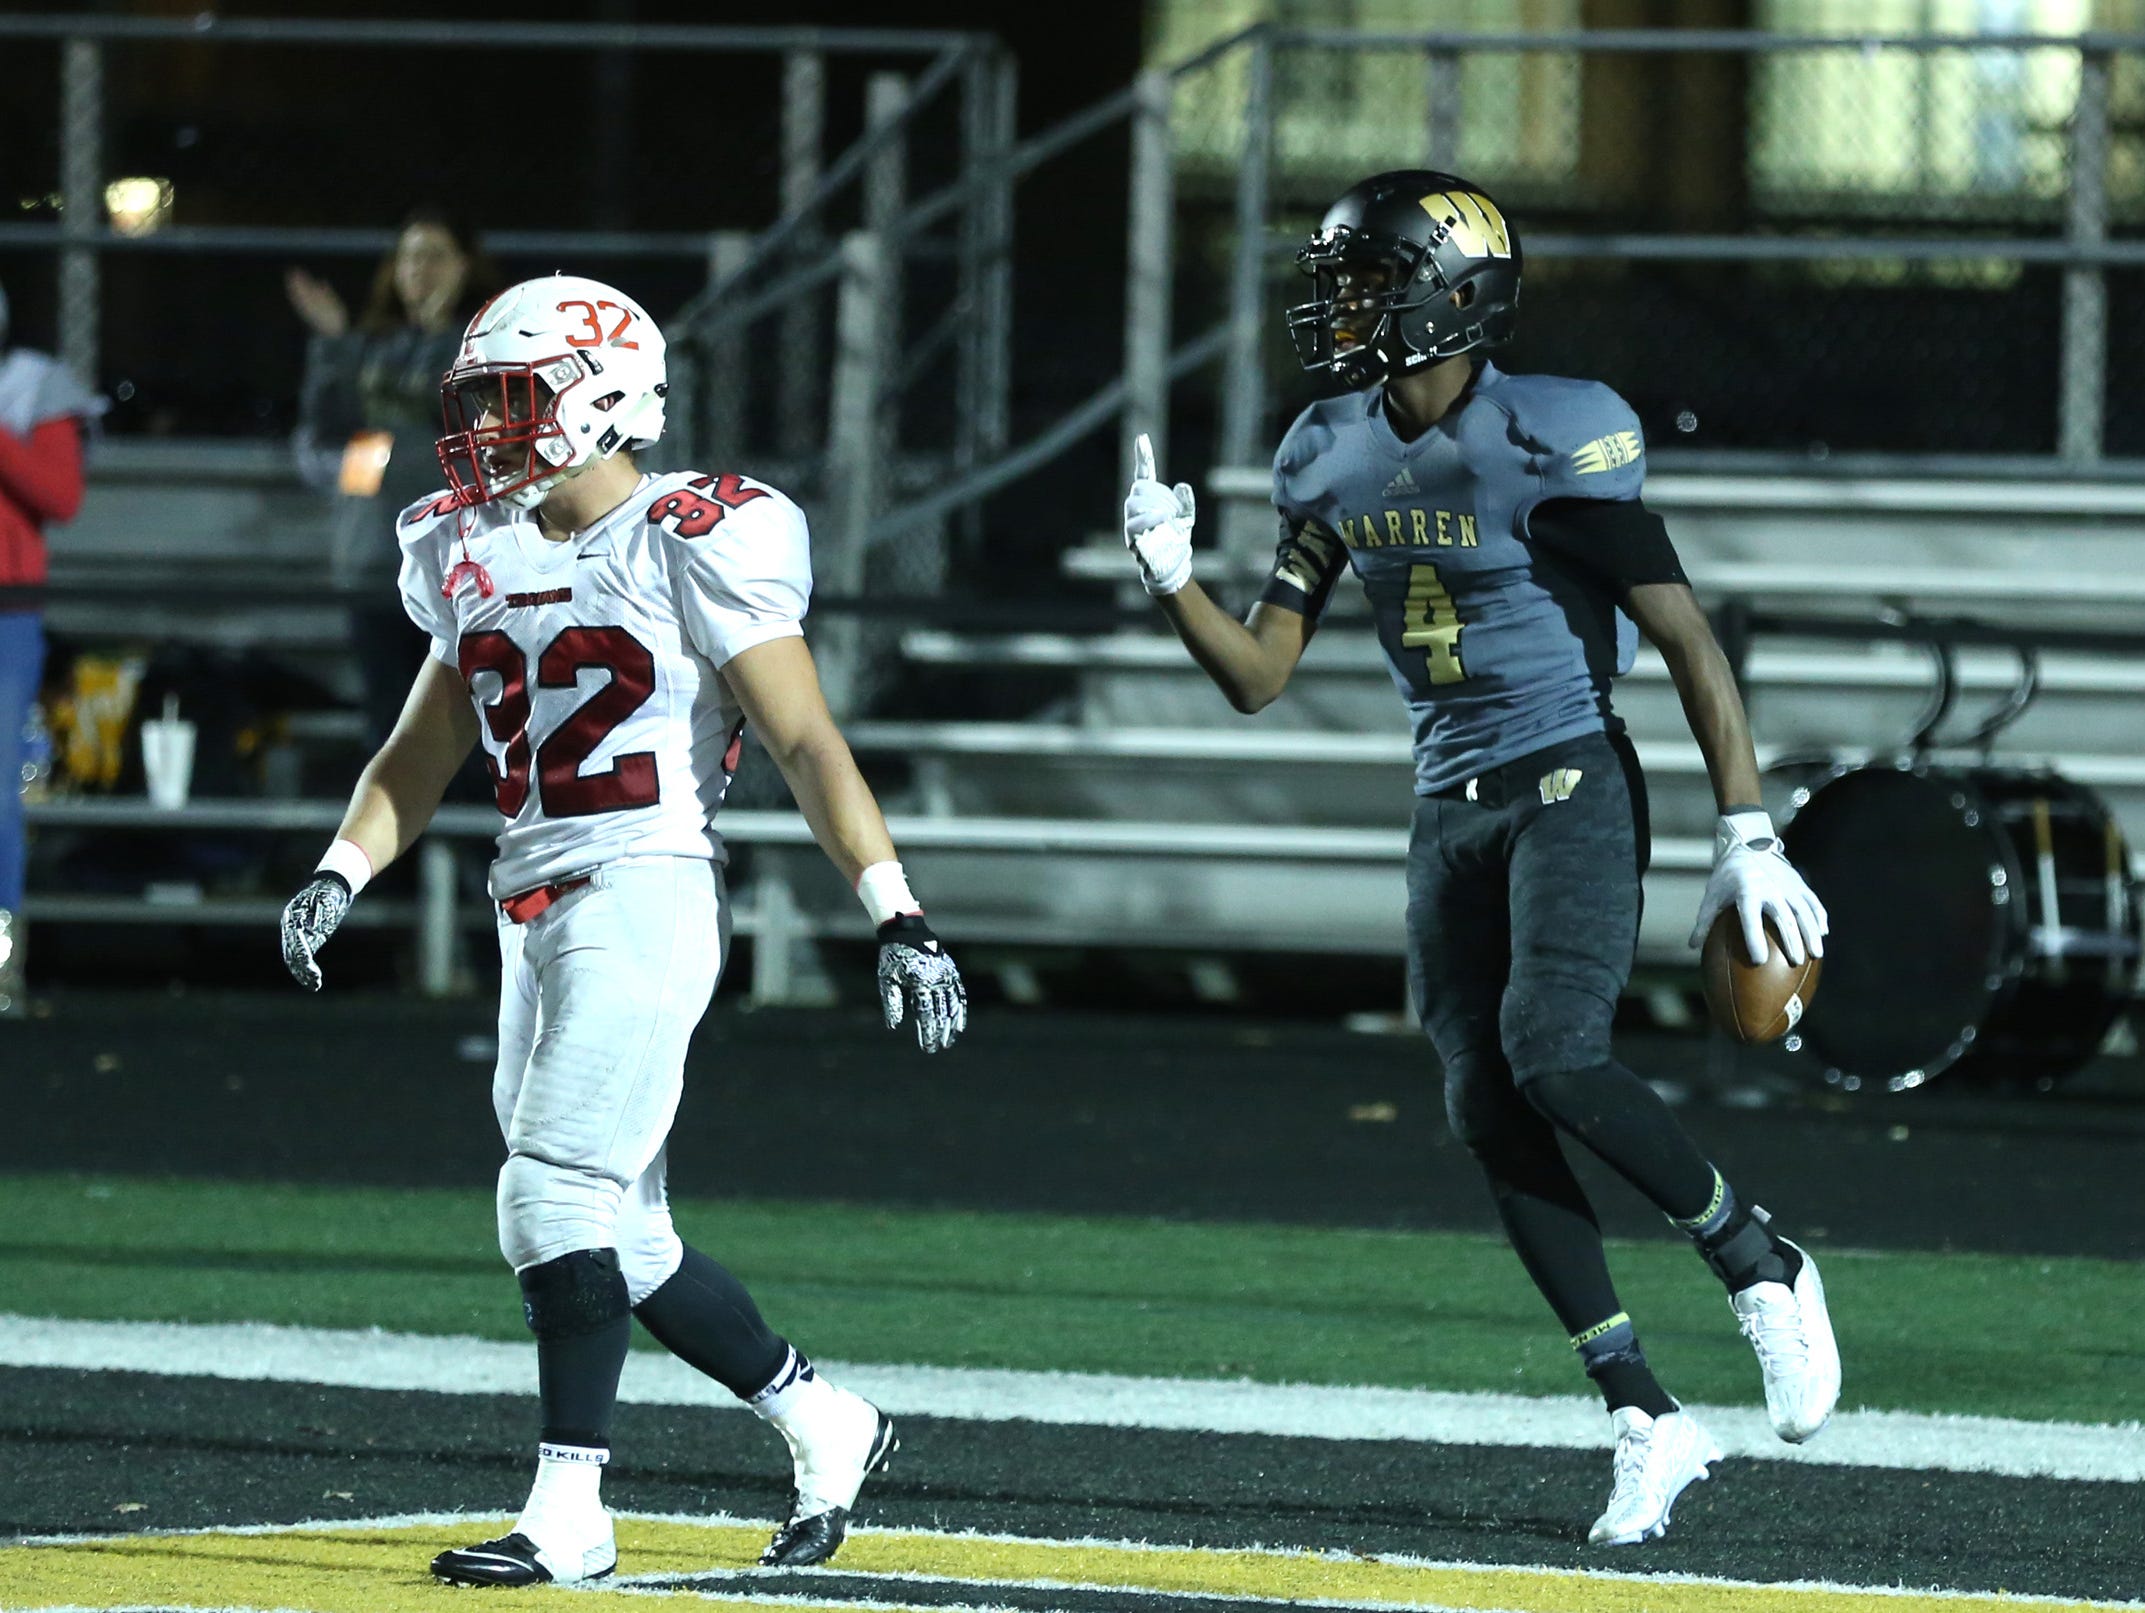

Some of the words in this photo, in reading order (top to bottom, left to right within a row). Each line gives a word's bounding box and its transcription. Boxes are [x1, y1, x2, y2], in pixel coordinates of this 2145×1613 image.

[1419, 190, 1512, 260] W
[556, 300, 640, 351] 32
[646, 473, 773, 540] 32
[1338, 508, 1480, 549] WARREN
[1401, 563, 1466, 686] 4
[457, 624, 661, 819] 32
[1539, 767, 1583, 805] W
[556, 1450, 604, 1463] KILLS
